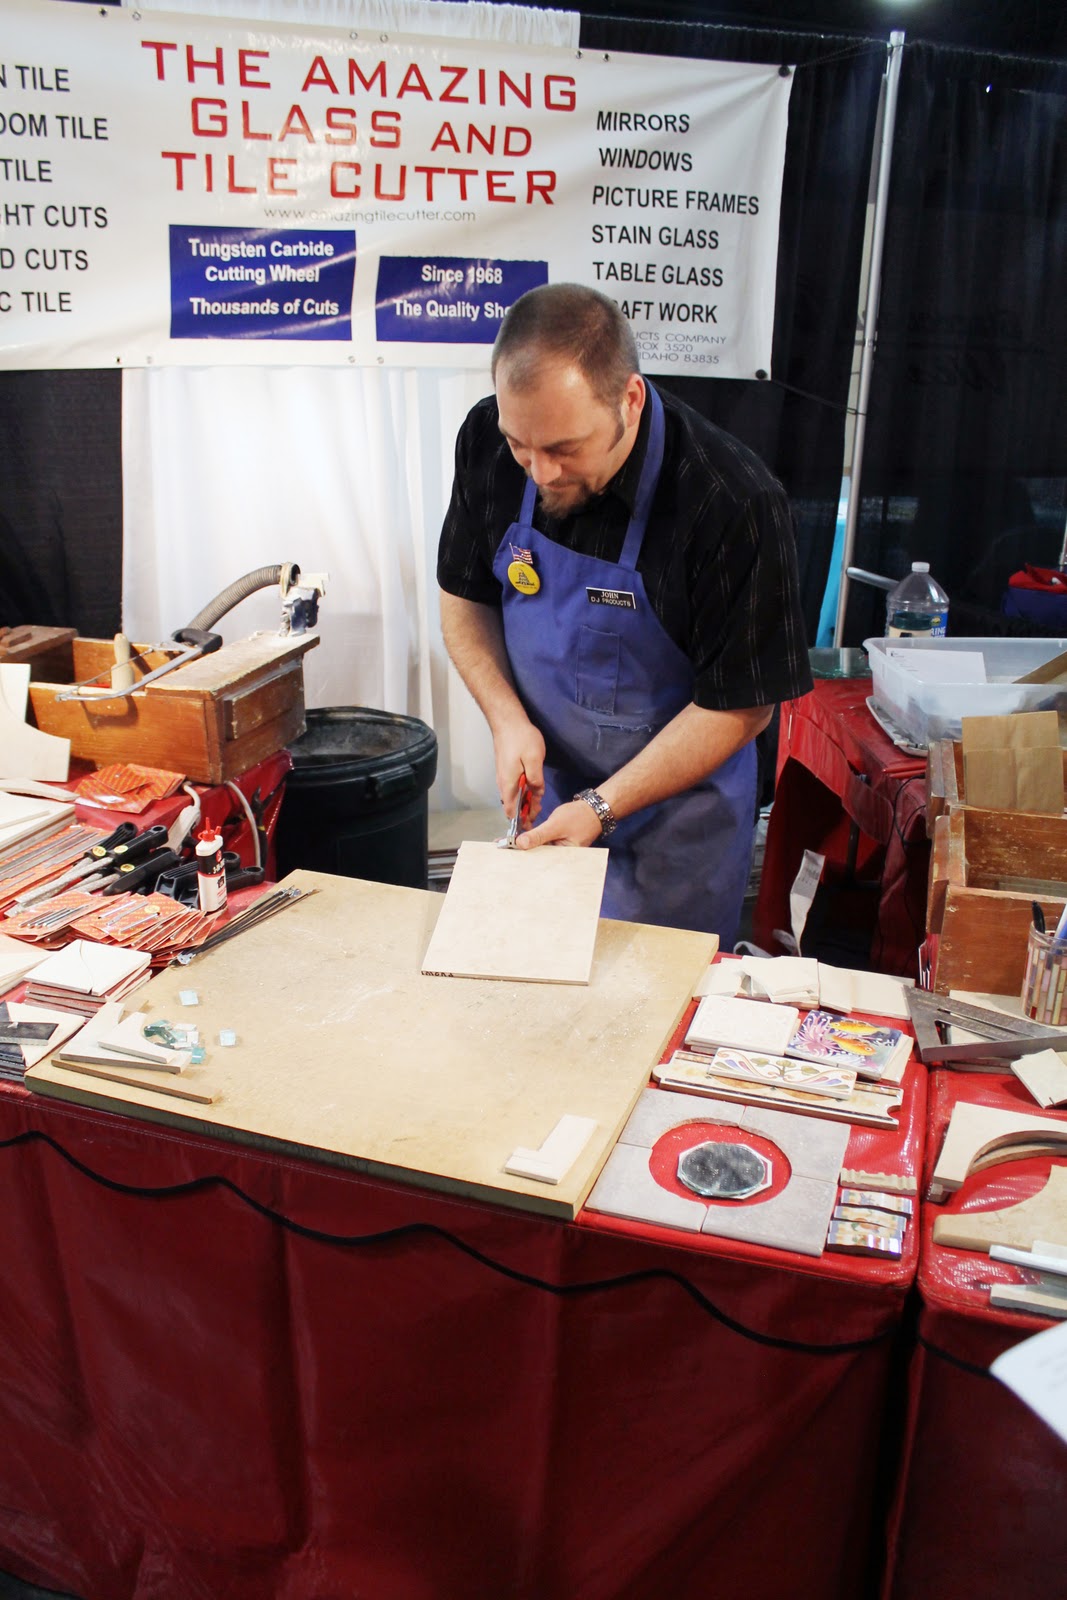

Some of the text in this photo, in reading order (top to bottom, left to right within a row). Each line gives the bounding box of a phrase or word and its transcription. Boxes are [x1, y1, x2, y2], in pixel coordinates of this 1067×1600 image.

[15, 65, 70, 92] TILE
[141, 40, 576, 112] THE AMAZING
[55, 115, 109, 140] TILE
[191, 97, 532, 157] GLASS AND
[596, 110, 690, 133] MIRRORS
[0, 158, 53, 183] TILE
[599, 147, 693, 172] WINDOWS
[161, 151, 557, 205] TILE CUTTER
[592, 185, 759, 215] PICTURE FRAMES
[44, 205, 108, 229] CUTS
[264, 208, 476, 224] wwwaazingtilecutter.com
[592, 224, 719, 250] STAIN GLASS
[25, 248, 89, 271] CUTS
[188, 237, 335, 262] Tungsten Carbide
[205, 264, 320, 285] Cutting Wheel
[421, 264, 503, 284] Since 1968
[592, 261, 723, 287] TABLE GLASS
[21, 291, 72, 313] TILE
[189, 297, 340, 315] Thousands of Cuts
[394, 299, 423, 317] The
[426, 300, 481, 322] Quality
[614, 300, 718, 324] AFT WORK
[665, 333, 727, 345] COMPANY
[665, 343, 694, 353] 3520
[639, 352, 720, 365] IDAHO 83835
[601, 591, 619, 600] JOHN
[602, 598, 631, 607] PRODUCTS
